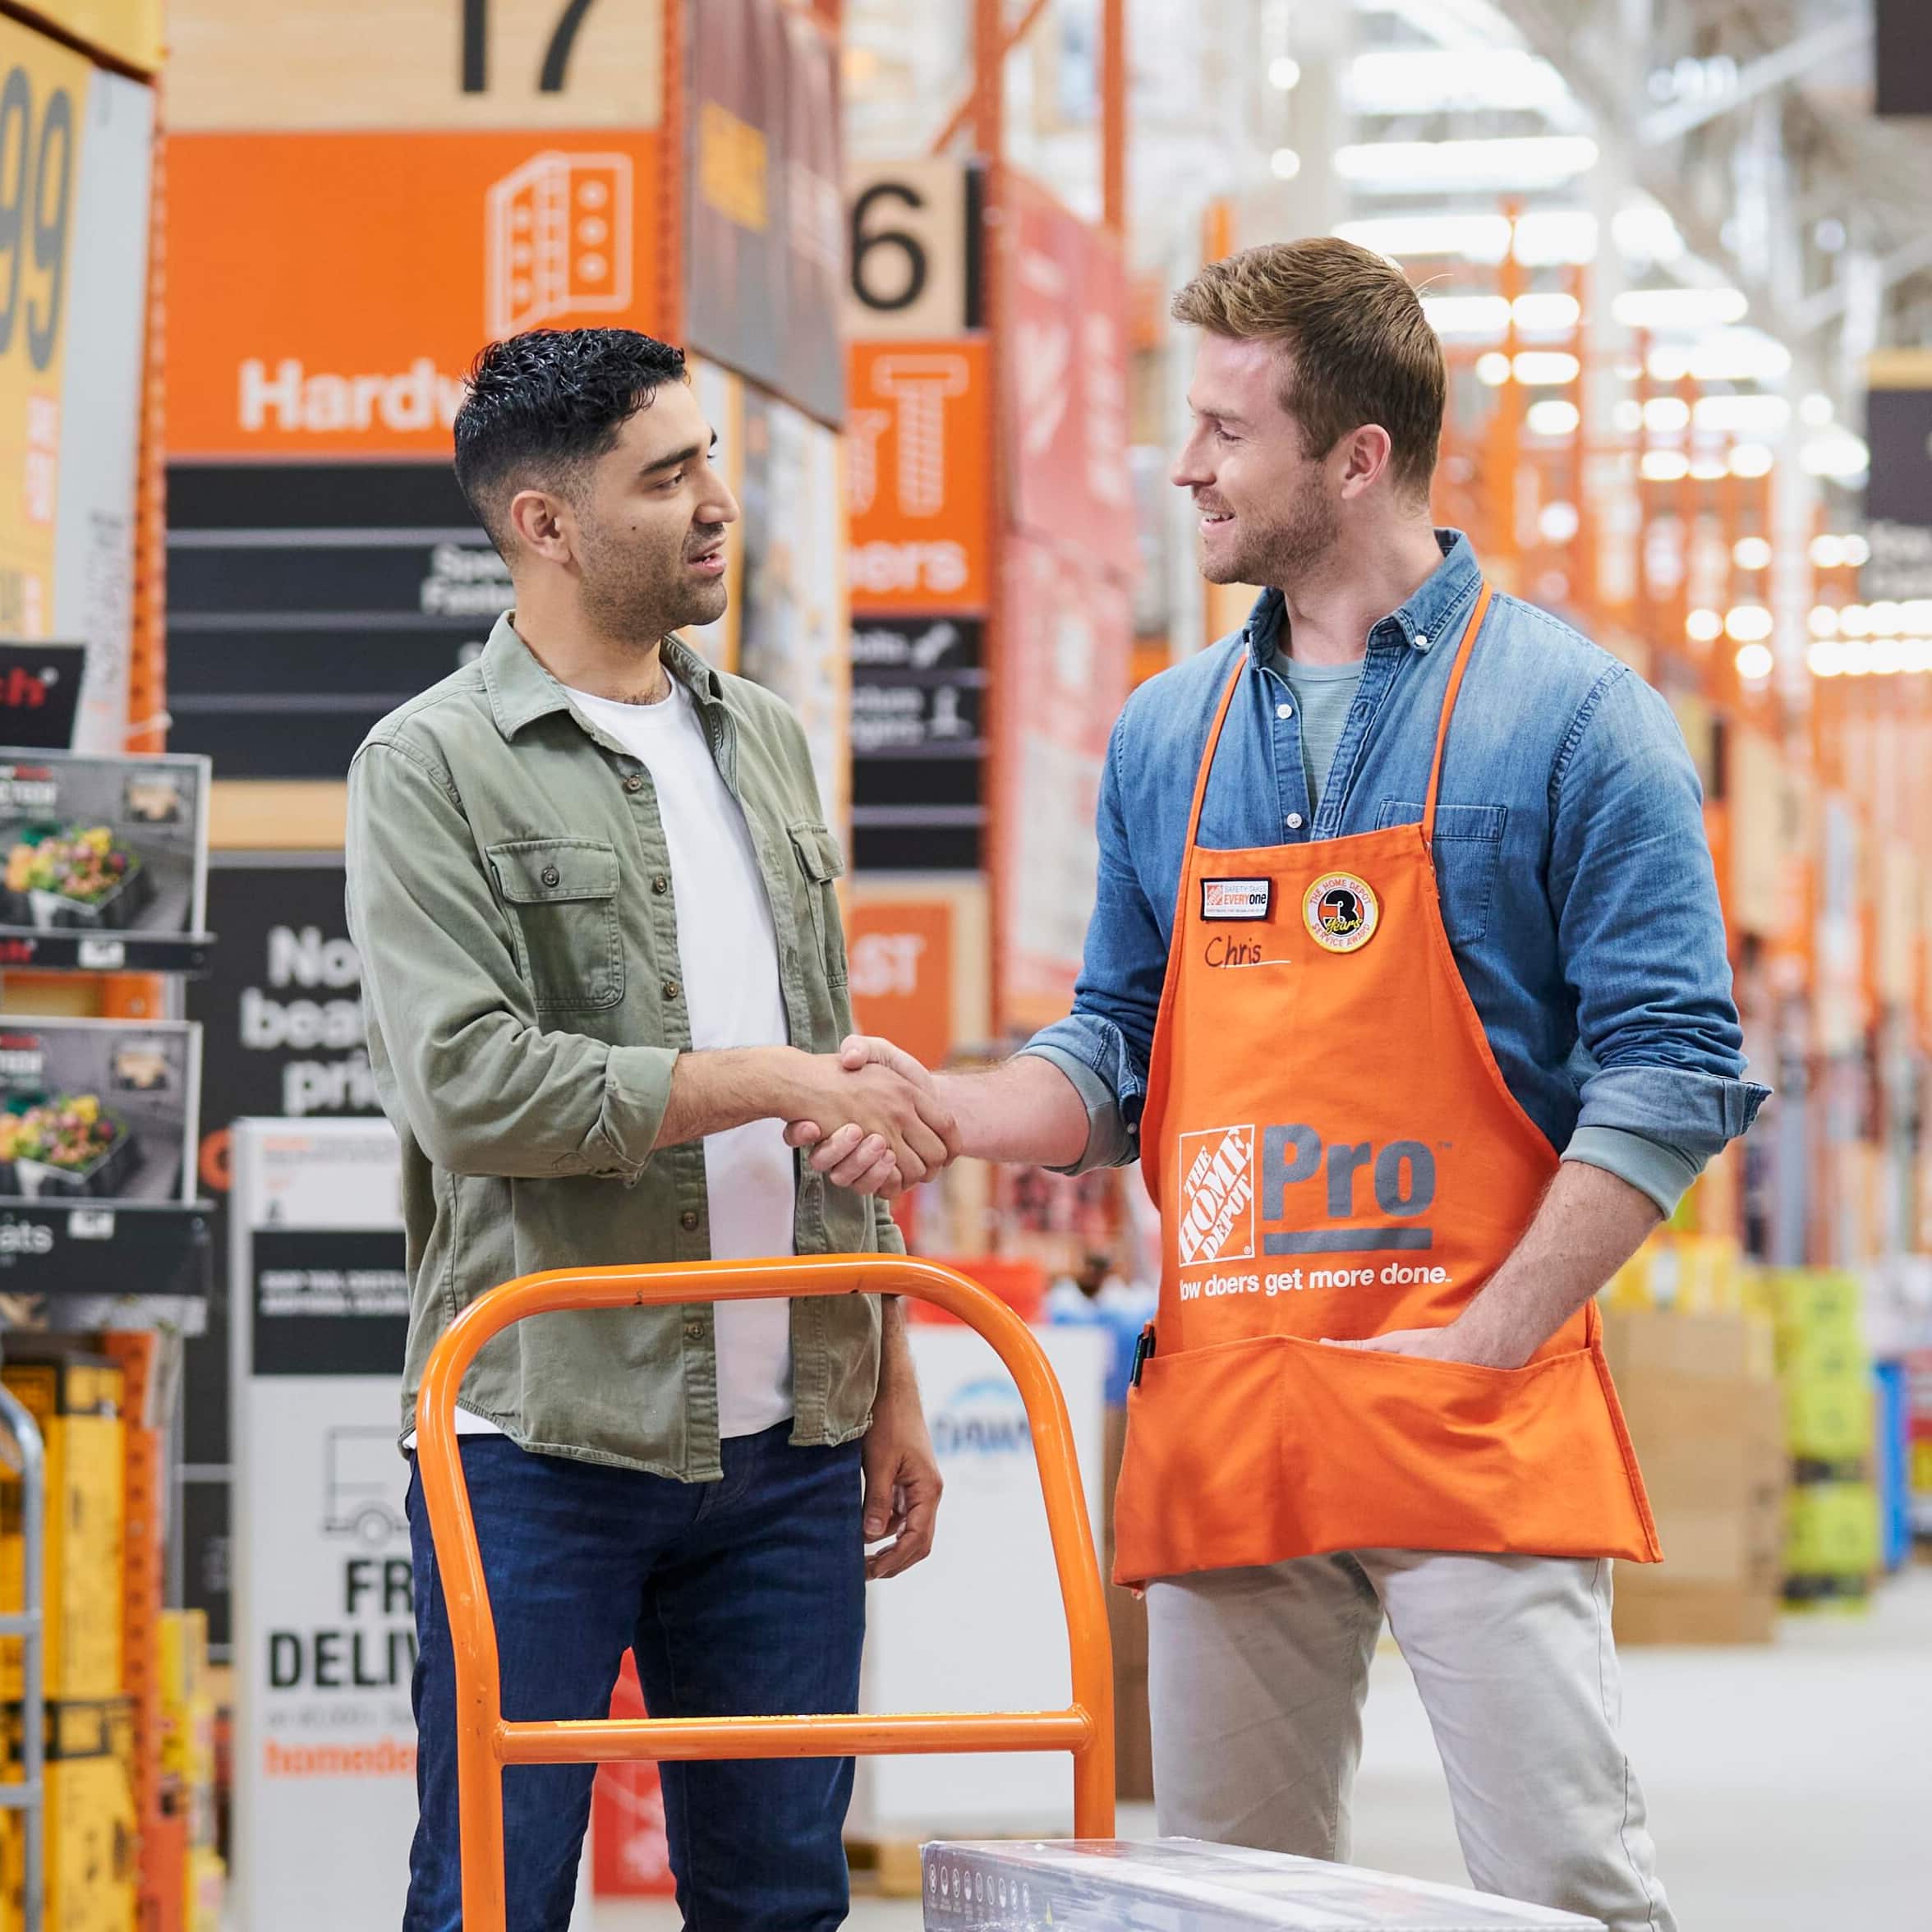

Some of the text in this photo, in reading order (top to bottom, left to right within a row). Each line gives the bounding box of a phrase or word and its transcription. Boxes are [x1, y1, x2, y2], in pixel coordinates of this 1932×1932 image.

[1309, 879, 1371, 904] THE HOME DEPOT
[1324, 890, 1359, 935] 3
[1204, 936, 1262, 969] Chris
[1312, 922, 1370, 946] SERVICE AWARD
[242, 987, 366, 1051] bea
[1180, 1128, 1252, 1263] HOME
[1184, 1145, 1212, 1200] THE
[1263, 1123, 1435, 1221] Pro
[1200, 1174, 1252, 1260] DEPOT
[1204, 1275, 1260, 1297] doers
[1265, 1268, 1303, 1296] get
[1309, 1268, 1374, 1289] more
[1380, 1263, 1453, 1285] done.
